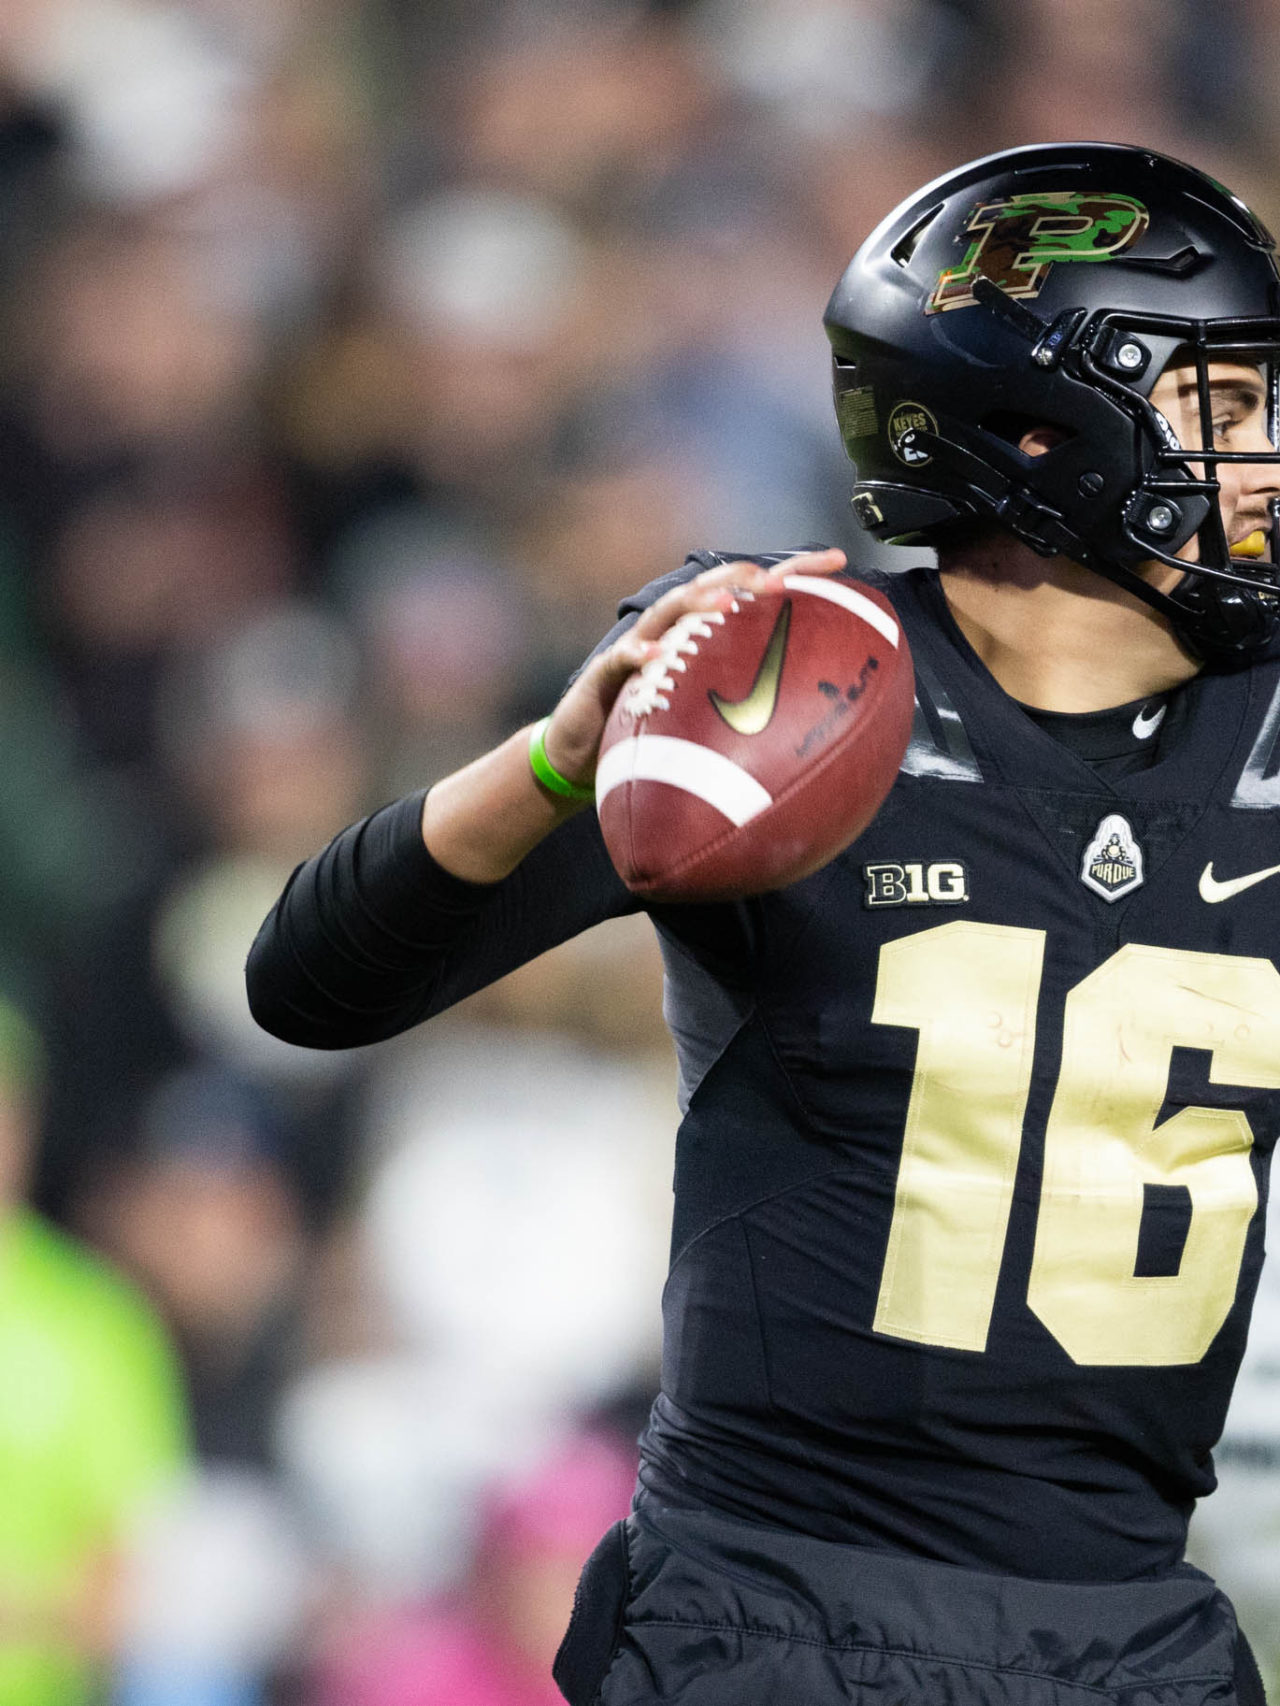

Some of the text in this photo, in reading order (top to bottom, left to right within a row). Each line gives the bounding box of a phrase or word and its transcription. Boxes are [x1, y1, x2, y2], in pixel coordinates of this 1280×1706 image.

[923, 192, 1149, 316] P
[893, 412, 926, 431] KEYES
[1091, 863, 1136, 884] PURDUE
